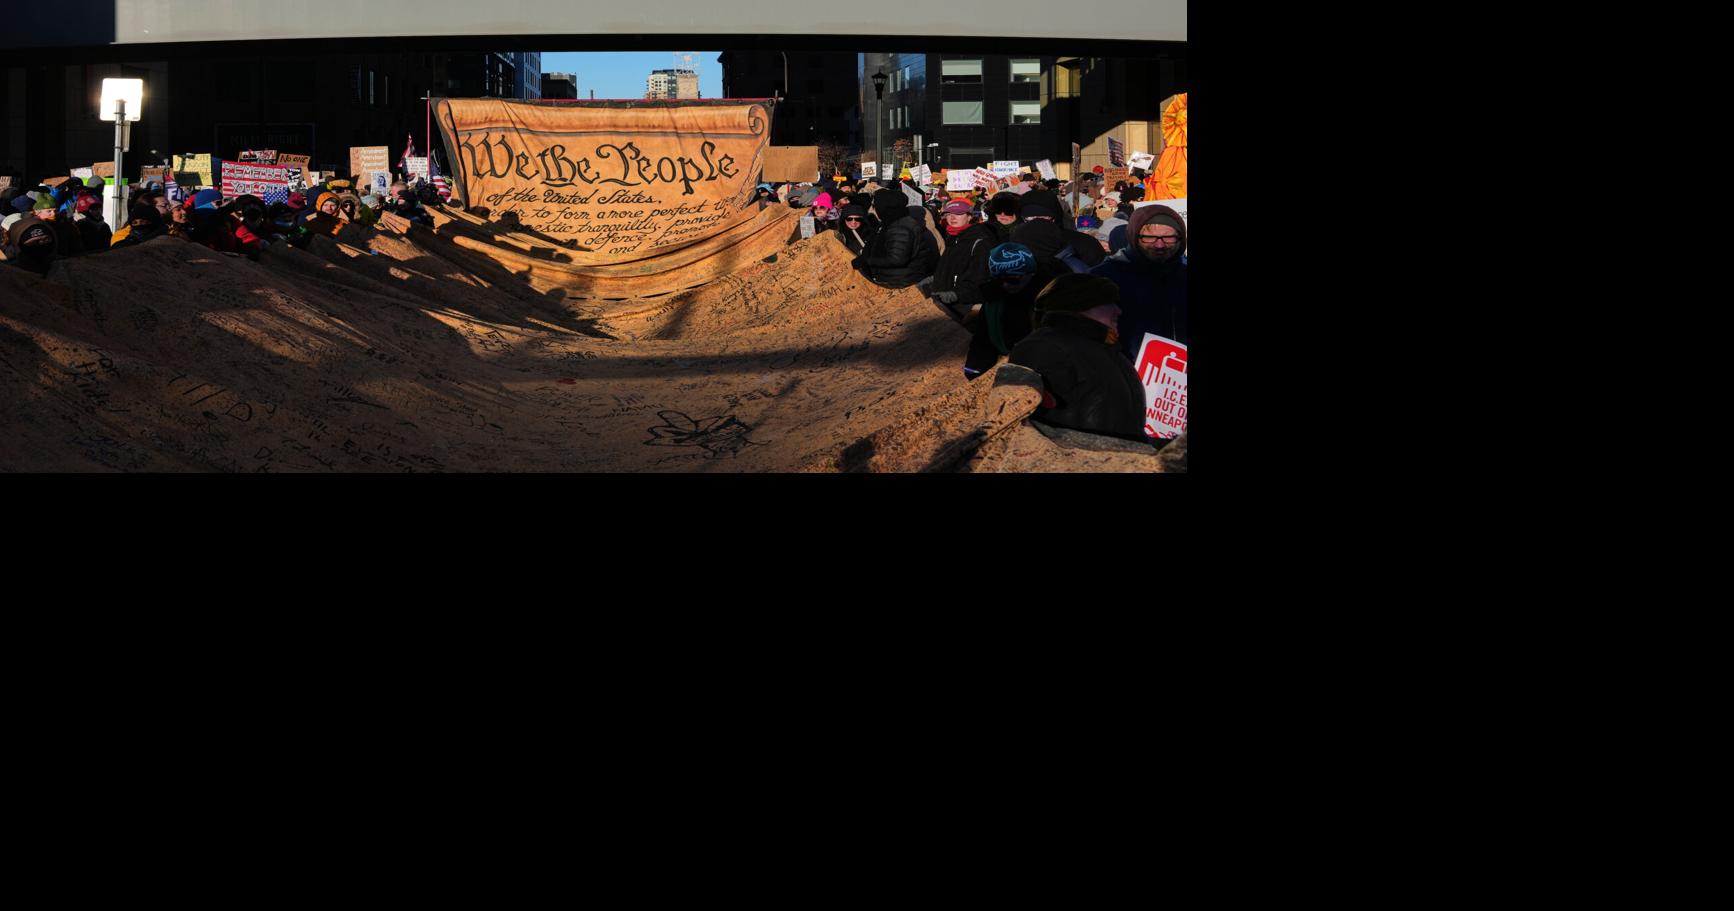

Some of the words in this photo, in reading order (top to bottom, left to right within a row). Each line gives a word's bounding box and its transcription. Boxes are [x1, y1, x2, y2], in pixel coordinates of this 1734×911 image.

[460, 131, 540, 180] We
[536, 144, 600, 187] the
[596, 141, 740, 197] People
[486, 187, 515, 206] of
[511, 187, 540, 203] the
[543, 188, 600, 205] United
[597, 189, 662, 204] States.
[530, 206, 553, 218] to
[546, 206, 592, 224] form
[607, 209, 644, 219] more
[640, 199, 710, 223] perfect
[609, 241, 642, 254] and
[1154, 397, 1177, 414] OUT
